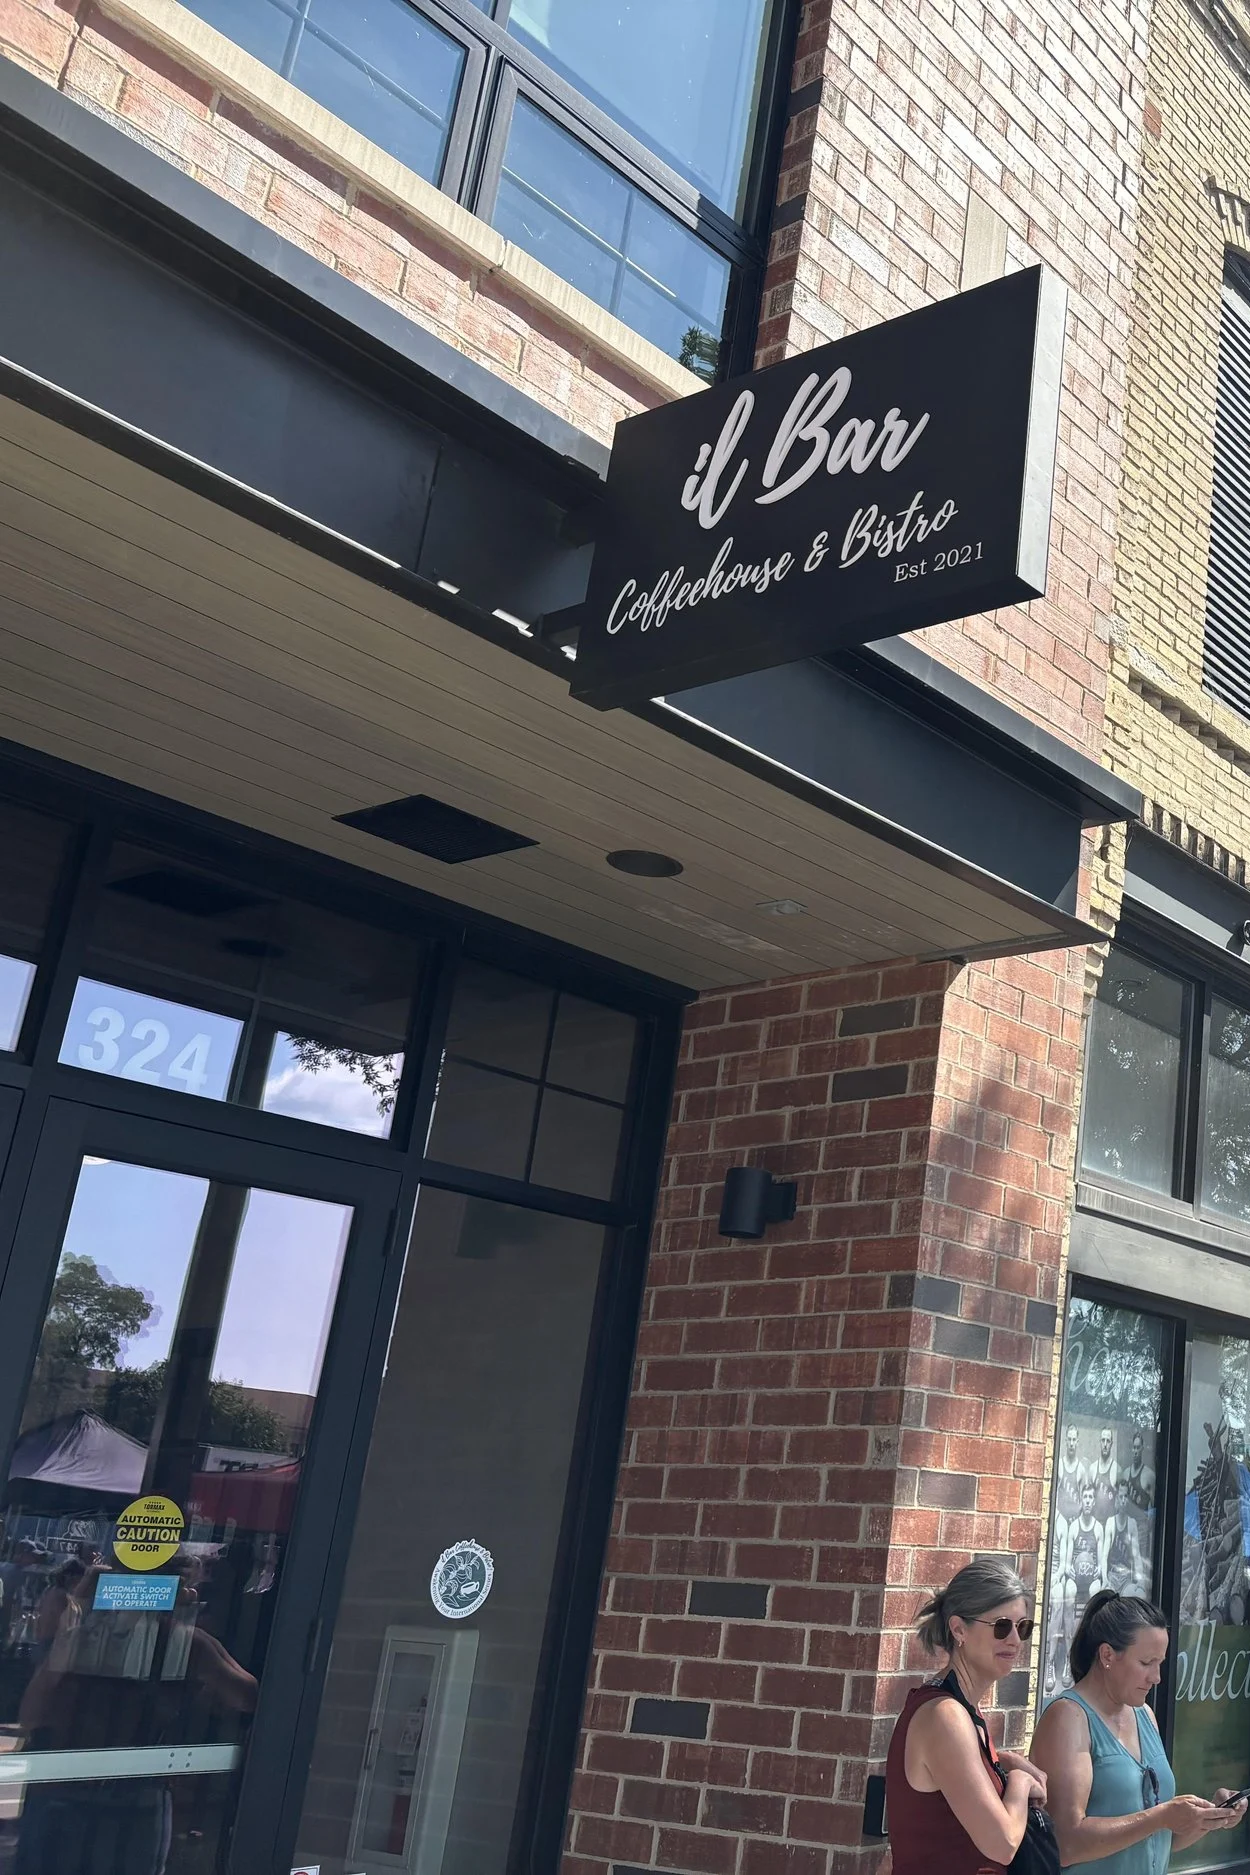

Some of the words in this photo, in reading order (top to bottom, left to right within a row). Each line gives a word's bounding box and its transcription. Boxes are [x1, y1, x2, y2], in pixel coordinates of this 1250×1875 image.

[681, 390, 755, 529] il
[754, 366, 930, 505] Bar
[606, 537, 795, 634] Coffeehouse
[803, 531, 829, 572] &
[839, 491, 958, 569] Bistro
[893, 558, 927, 583] Est
[933, 541, 984, 572] 2021
[78, 1006, 212, 1092] 324
[121, 1515, 181, 1525] AUTOMATIC
[116, 1527, 180, 1542] CAUTION
[131, 1544, 159, 1552] DOOR
[102, 1585, 147, 1594] AUTOMATIC
[149, 1586, 171, 1594] DOOR
[102, 1592, 139, 1600] ACTIVATE
